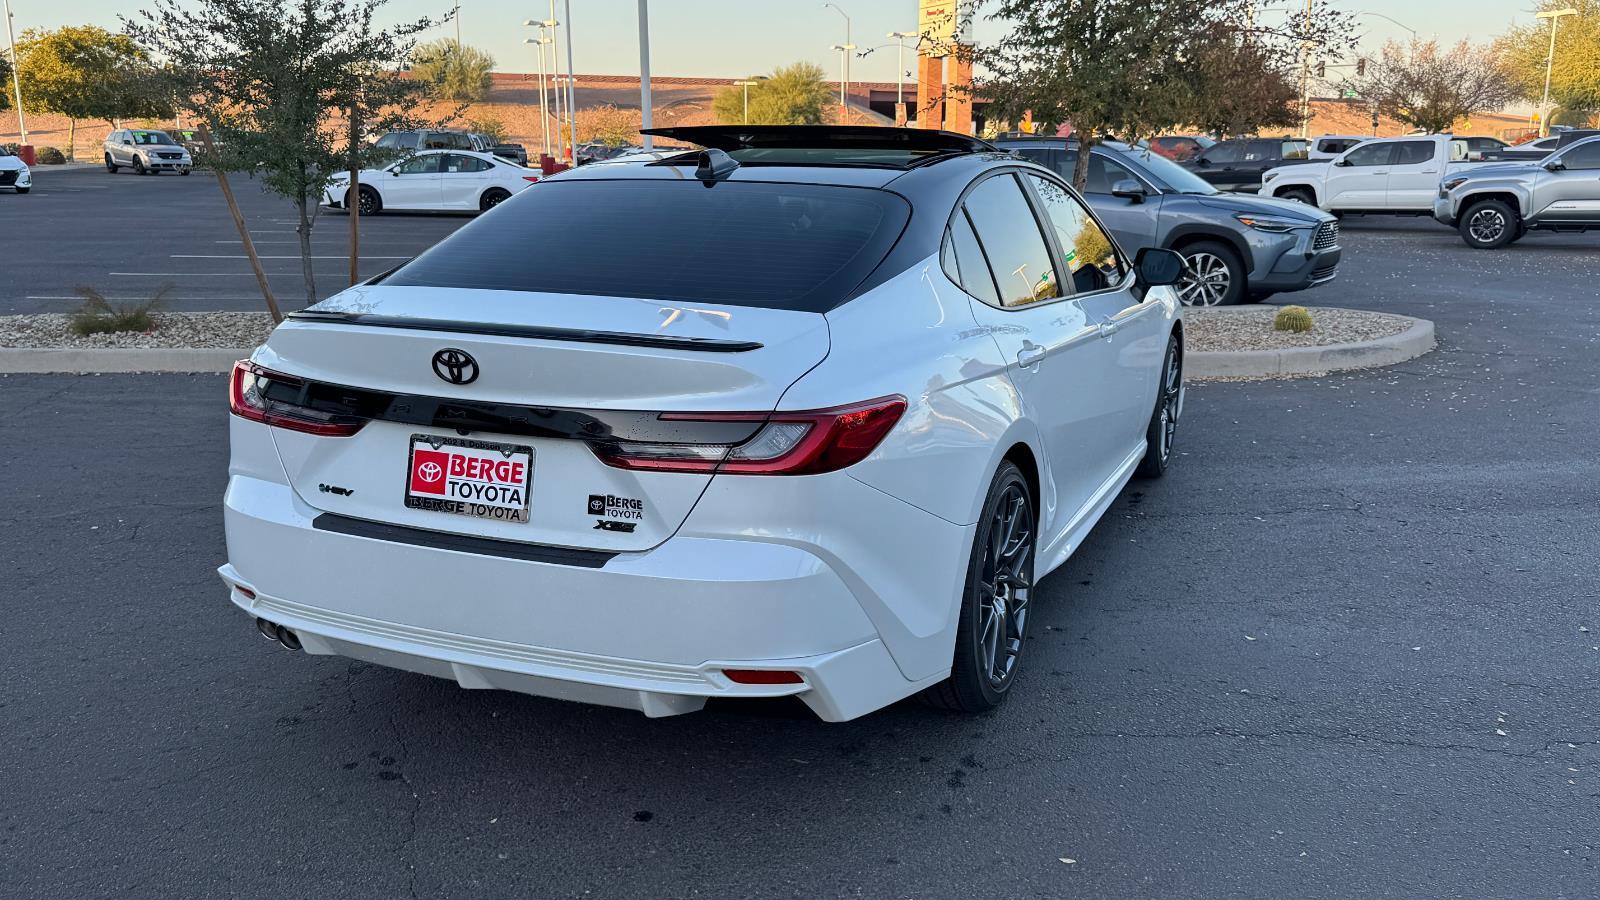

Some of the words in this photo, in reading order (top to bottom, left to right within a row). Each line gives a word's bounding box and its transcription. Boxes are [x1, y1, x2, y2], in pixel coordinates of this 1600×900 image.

[450, 454, 524, 484] BERGE
[448, 481, 522, 505] TOYOTA
[606, 494, 643, 510] BERGE
[410, 498, 465, 512] BERGE
[469, 503, 521, 520] TOYOTA
[606, 508, 643, 520] TOYOTA
